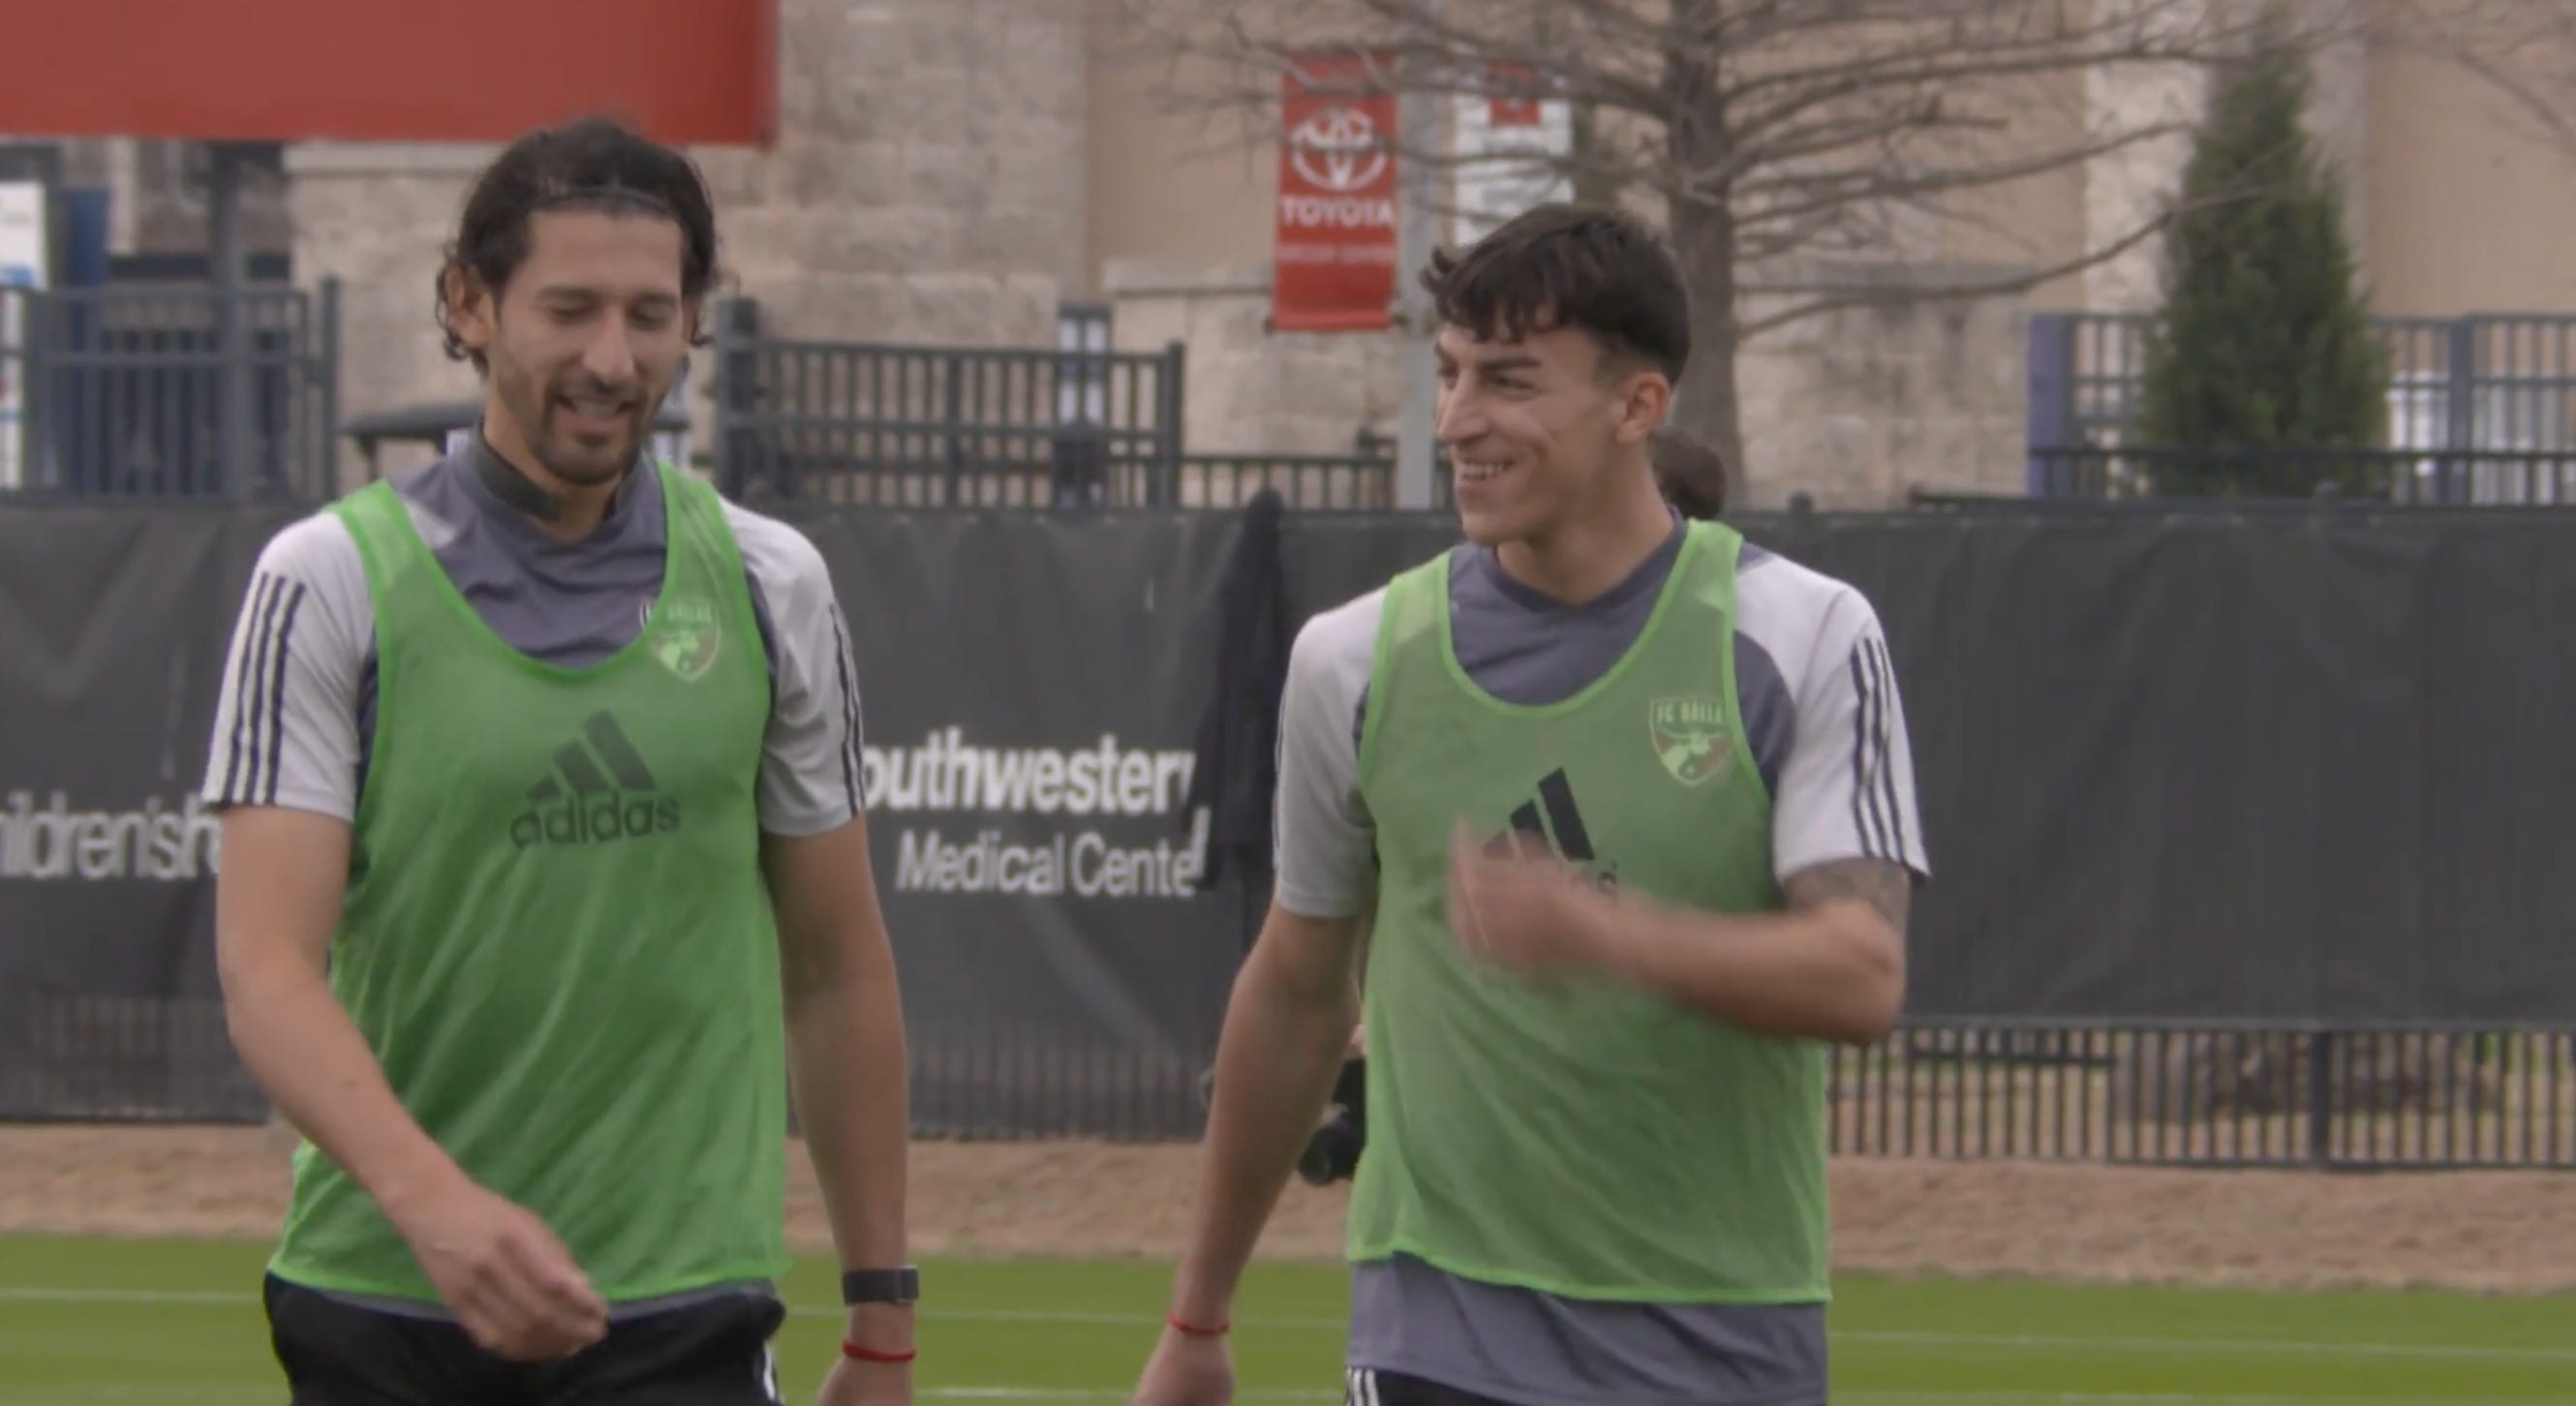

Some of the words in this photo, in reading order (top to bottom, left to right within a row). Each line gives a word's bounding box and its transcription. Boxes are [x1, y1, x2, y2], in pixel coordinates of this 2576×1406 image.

[1281, 196, 1395, 229] TOYOTA
[863, 725, 1197, 815] outhwestern
[509, 790, 681, 848] adidas
[897, 829, 1064, 895] Medical
[1071, 831, 1201, 898] Cente
